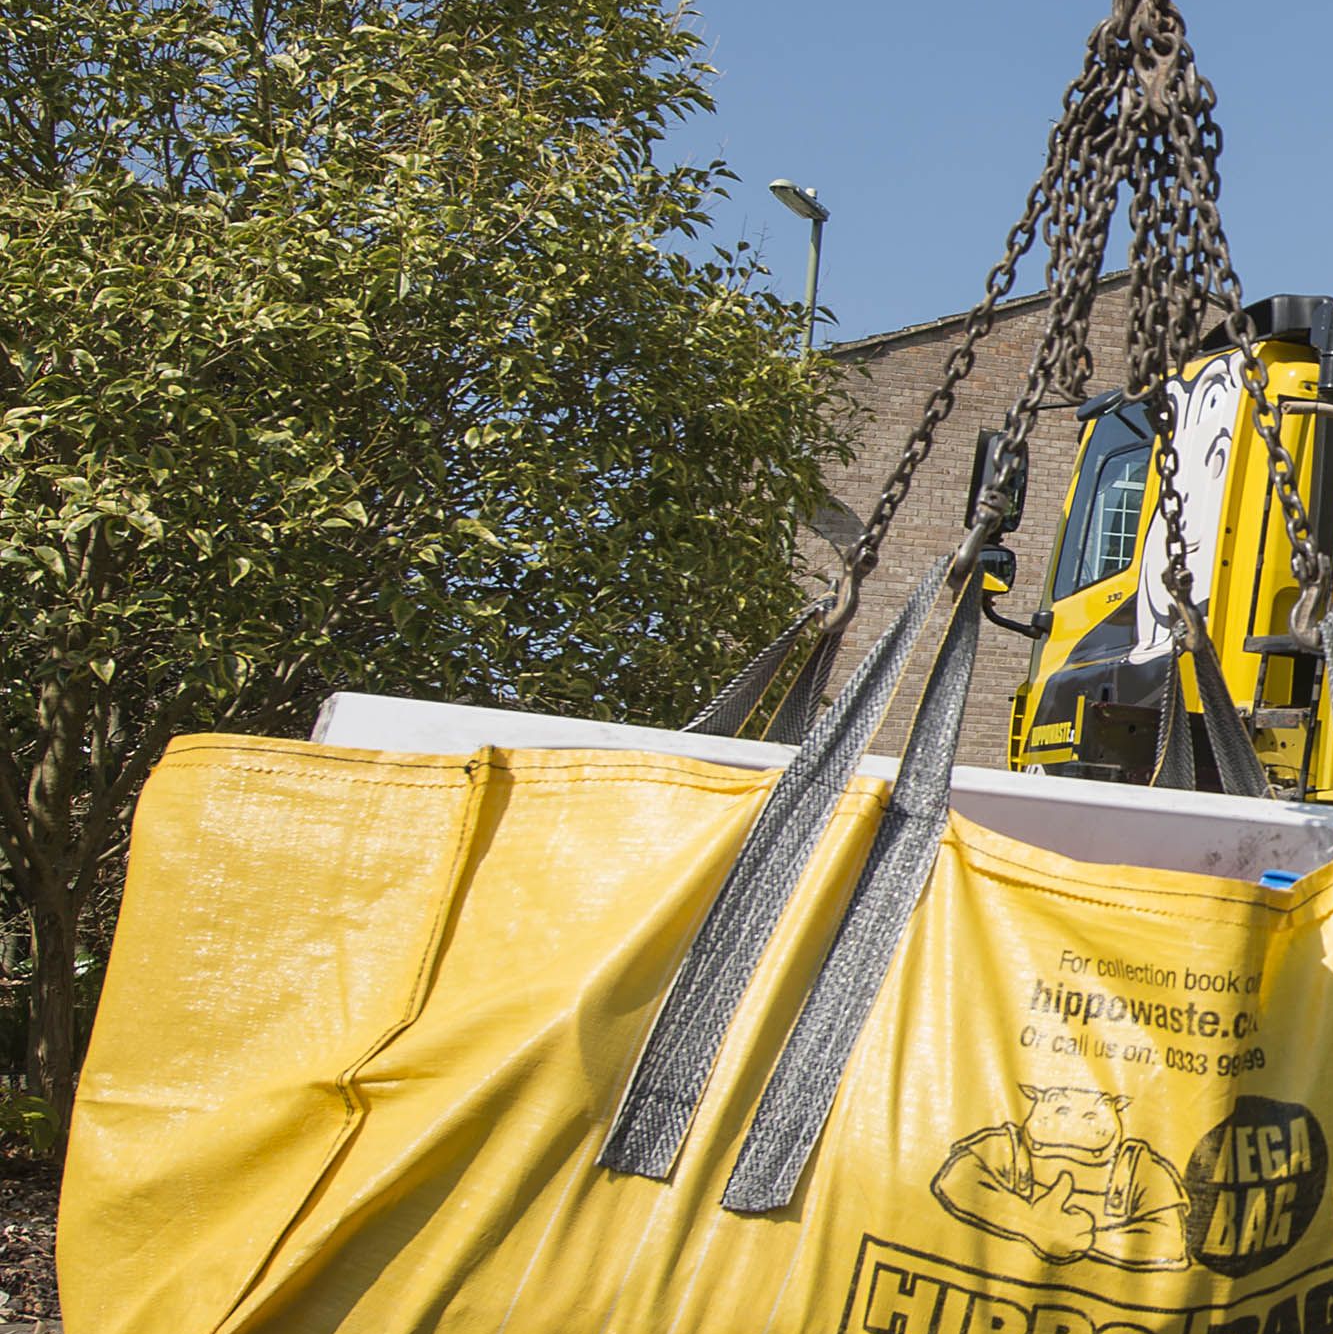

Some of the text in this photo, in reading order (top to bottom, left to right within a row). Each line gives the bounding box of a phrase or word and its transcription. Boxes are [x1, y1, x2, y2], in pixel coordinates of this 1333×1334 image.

[1059, 949, 1091, 973] For
[1097, 958, 1177, 989] collection
[1184, 967, 1240, 994] book
[1020, 1024, 1048, 1049] Or
[1052, 1033, 1089, 1057] call
[1094, 1041, 1118, 1056] us
[1165, 1046, 1208, 1076] 0333
[1202, 1182, 1297, 1256] BAG
